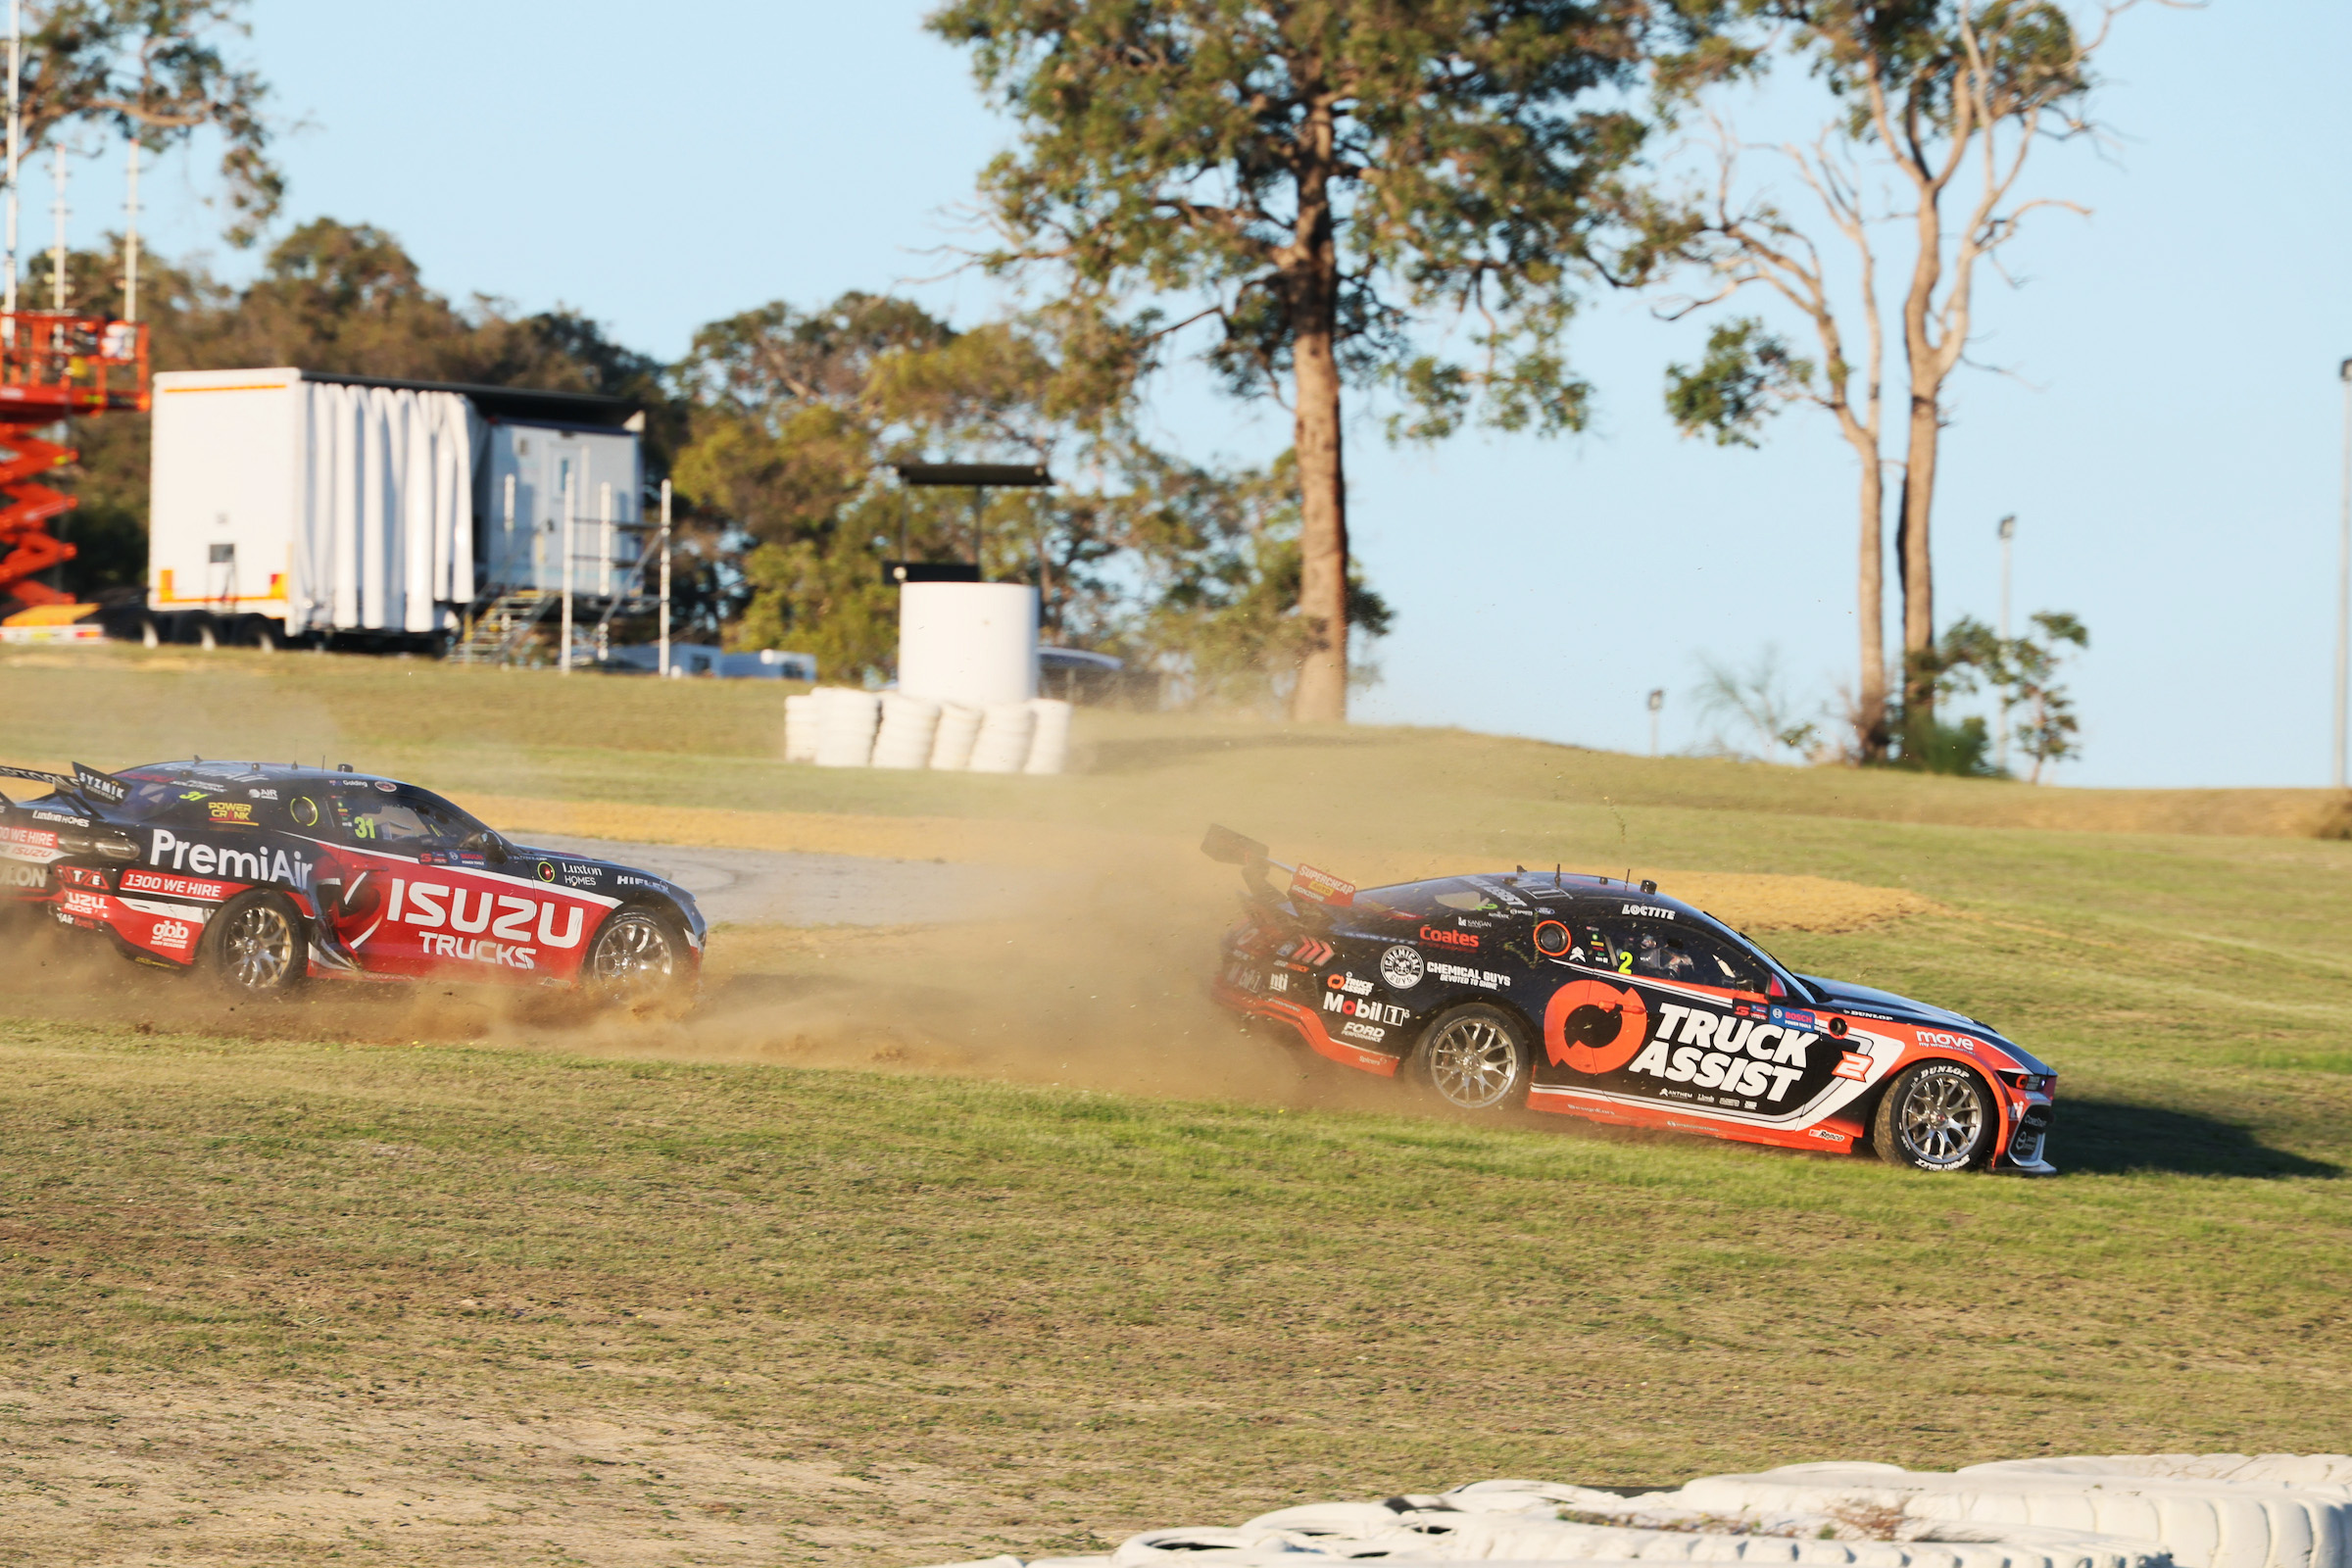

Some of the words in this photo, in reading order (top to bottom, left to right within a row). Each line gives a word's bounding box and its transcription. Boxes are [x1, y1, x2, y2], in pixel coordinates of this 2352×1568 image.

[78, 771, 125, 800] SYZMIK
[208, 802, 252, 812] POWER
[32, 809, 62, 822] Luxton
[62, 815, 90, 828] HOMES
[354, 816, 375, 839] 31
[11, 827, 26, 843] WE
[26, 831, 55, 847] HIRE
[12, 847, 53, 858] ISUZU
[149, 828, 314, 890] PremiAir
[562, 862, 603, 876] Luxton
[124, 873, 162, 889] 1300
[163, 878, 185, 893] WE
[187, 883, 221, 898] HIRE
[564, 875, 596, 886] HOMES
[1298, 865, 1354, 895] SUPERCHEAP
[386, 878, 584, 949] ISUZU
[1621, 904, 1676, 920] LOCTITE
[152, 919, 189, 940] gbb
[1419, 925, 1480, 948] Coates
[418, 930, 536, 970] TRUCKS
[1384, 948, 1420, 969] CHEMICAL
[1618, 951, 1634, 975] 2
[1269, 972, 1289, 992] nti
[1346, 977, 1374, 990] TRUCK
[1390, 974, 1413, 984] GUYS
[1427, 960, 1481, 980] CHEMICAL
[1483, 970, 1511, 987] GUYS
[1440, 973, 1469, 985] DEVOTED
[1470, 978, 1479, 987] TO
[1479, 980, 1497, 991] SHINE
[1341, 985, 1372, 997] ASSIST
[1323, 991, 1383, 1021] Mobil
[1390, 1008, 1398, 1024] 1
[1785, 1011, 1813, 1023] BOSCH
[1850, 1009, 1893, 1021] DUNLOP
[1341, 1030, 1383, 1043] PERFORMANCE
[1344, 1021, 1386, 1038] FORD
[1655, 1002, 1820, 1068] TRUCK
[1916, 1030, 1975, 1052] move
[1628, 1039, 1804, 1102] ASSIST
[1833, 1052, 1874, 1081] 2
[1920, 1065, 1971, 1079] DUNLOP
[1667, 1090, 1693, 1100] ANTHEM
[1819, 1129, 1845, 1143] Repco
